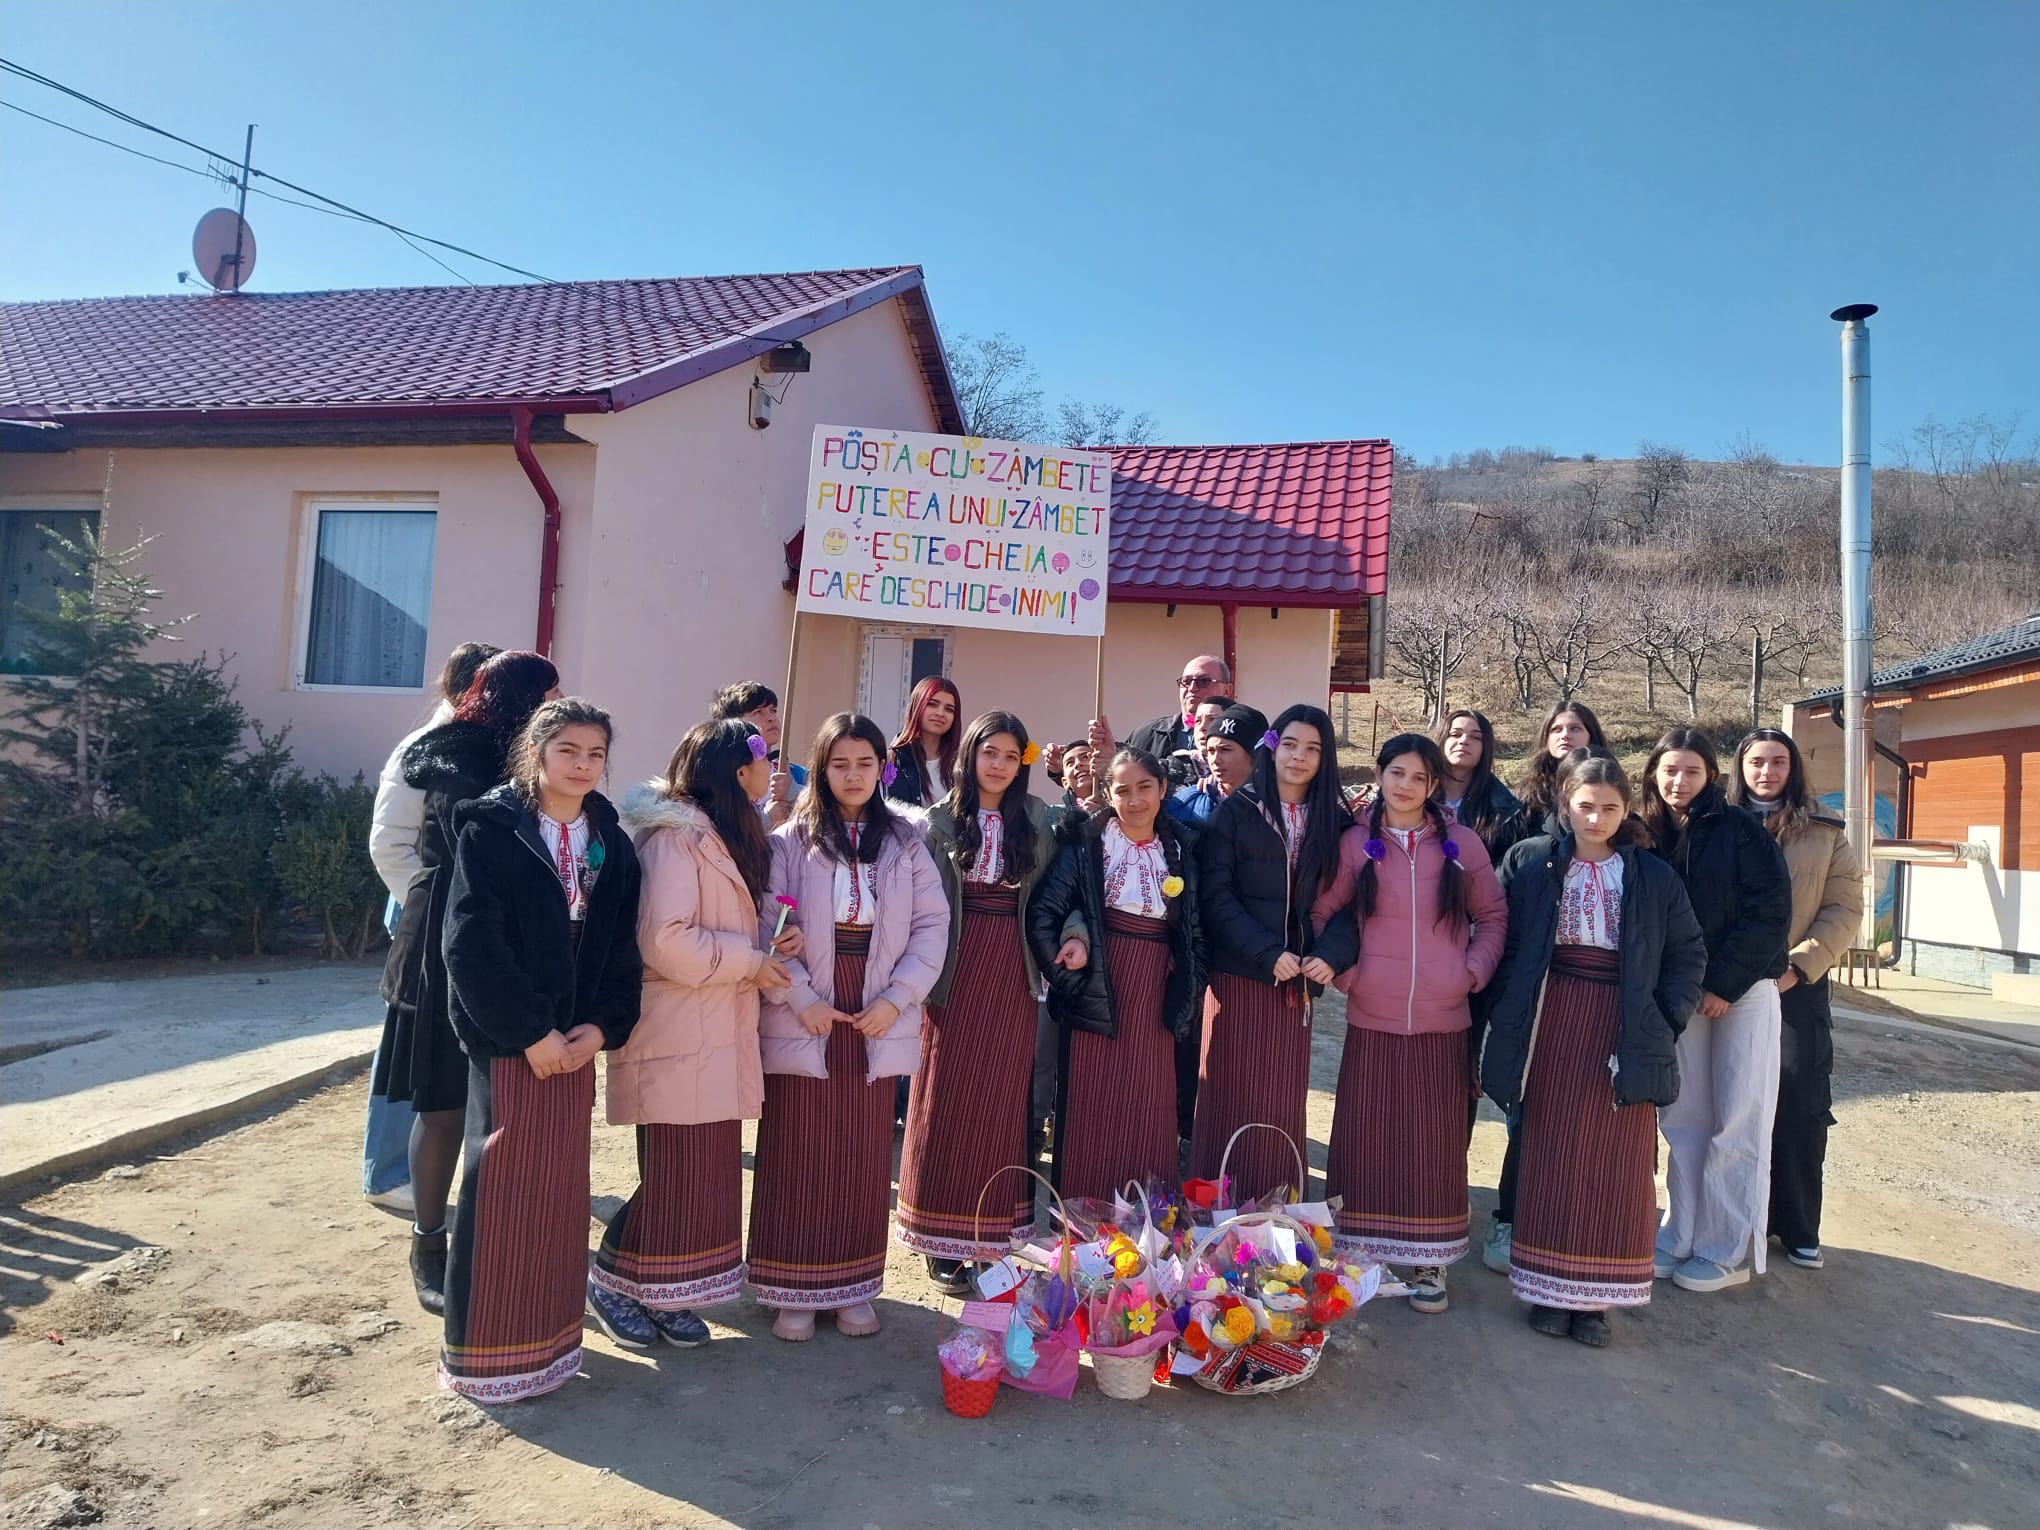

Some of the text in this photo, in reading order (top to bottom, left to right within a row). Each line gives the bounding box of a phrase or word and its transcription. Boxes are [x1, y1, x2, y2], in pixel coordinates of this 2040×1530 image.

[823, 437, 1108, 493] POȘTA CU ZÂMBETE
[817, 482, 1106, 535] PUTEREA UNUI ZÂMBET
[872, 531, 1047, 574] ESTE CHEIA
[808, 568, 1078, 625] CARE DESCHIDE INIMI!
